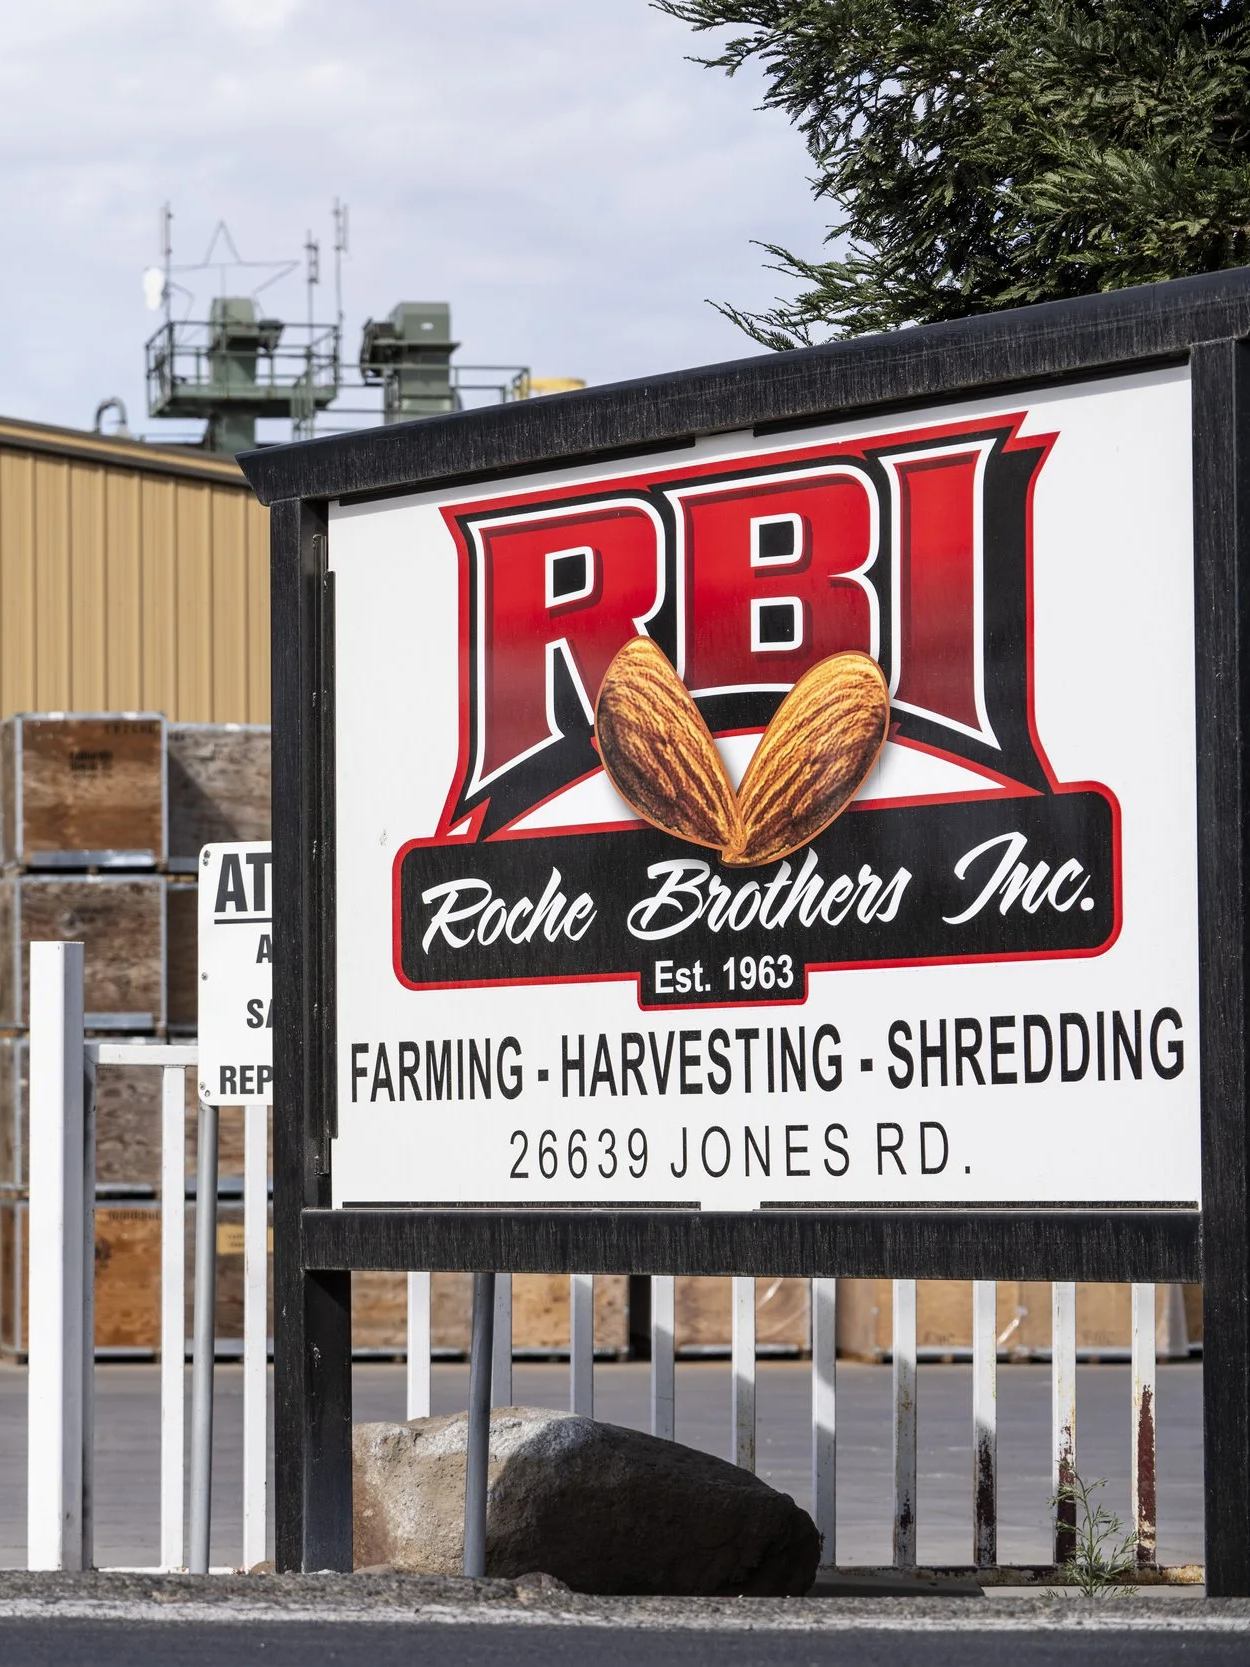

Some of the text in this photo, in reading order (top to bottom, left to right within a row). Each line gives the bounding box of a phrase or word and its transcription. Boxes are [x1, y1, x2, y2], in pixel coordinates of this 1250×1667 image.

[464, 434, 1006, 802] RBI
[420, 831, 1095, 954] Roche Brothers Inc.
[654, 954, 795, 994] Est. 1963
[351, 1036, 524, 1103] FARMING
[561, 1023, 843, 1098] HARVESTING
[887, 1006, 1186, 1089] SHREDDING
[509, 1121, 972, 1180] 26639 JONES RD.
